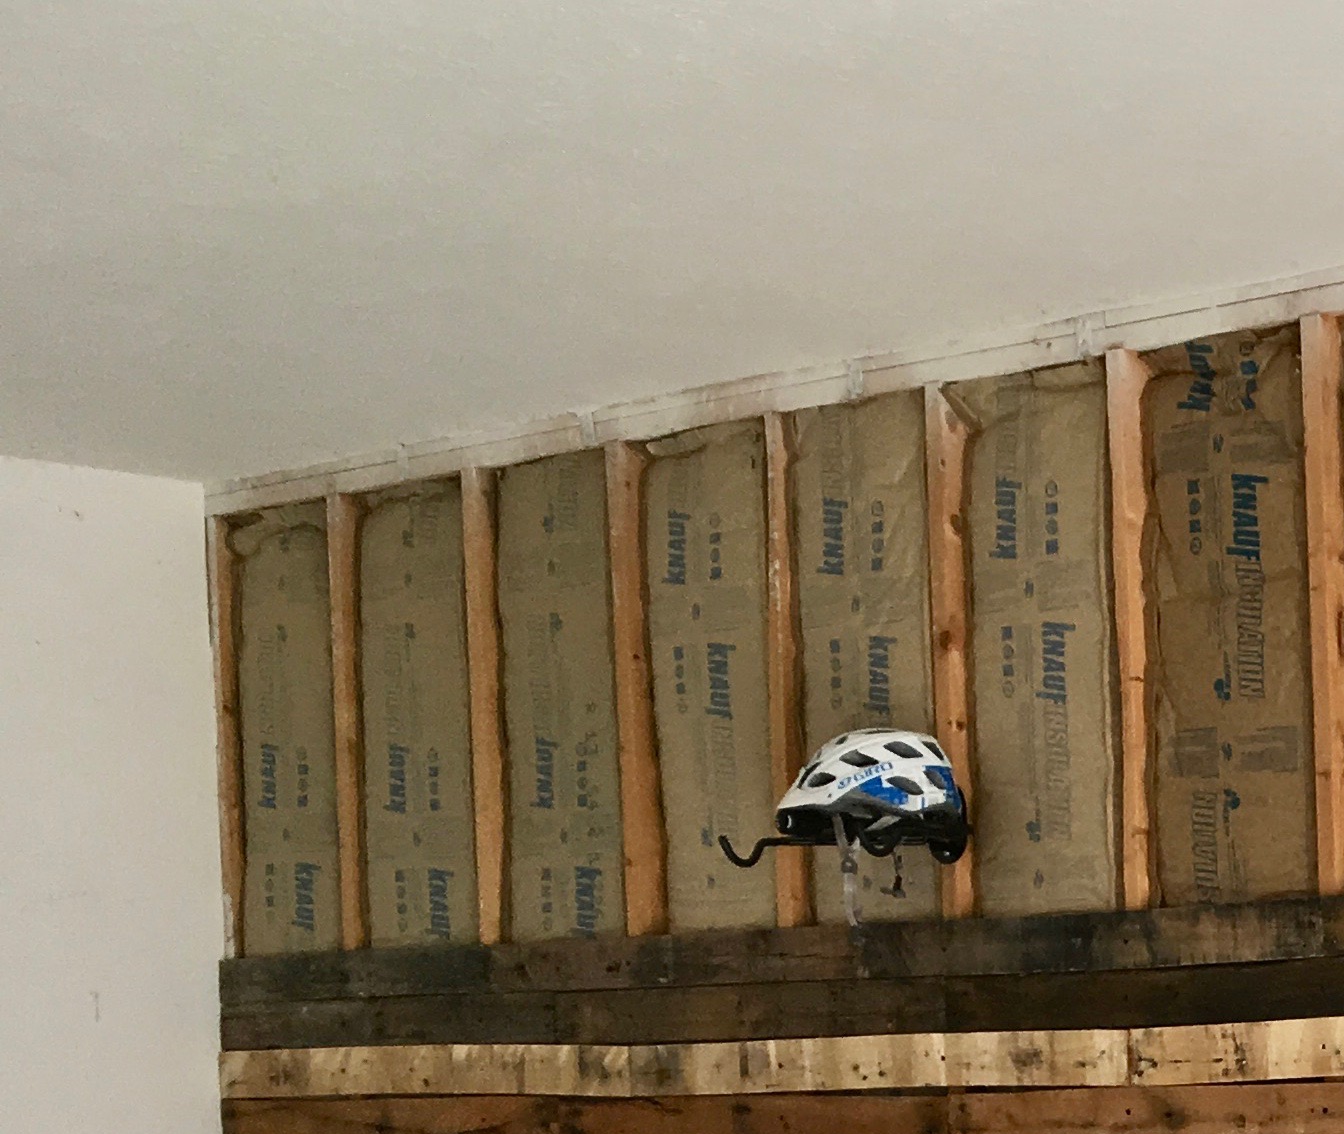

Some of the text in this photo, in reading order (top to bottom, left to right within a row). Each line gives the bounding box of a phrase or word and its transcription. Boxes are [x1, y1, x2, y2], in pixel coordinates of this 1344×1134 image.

[662, 509, 692, 585] KNAUF
[816, 498, 848, 575] KNAUF
[989, 476, 1021, 559] KNAUF
[1224, 473, 1269, 561] KNAUF
[1035, 621, 1076, 704] KNAUF
